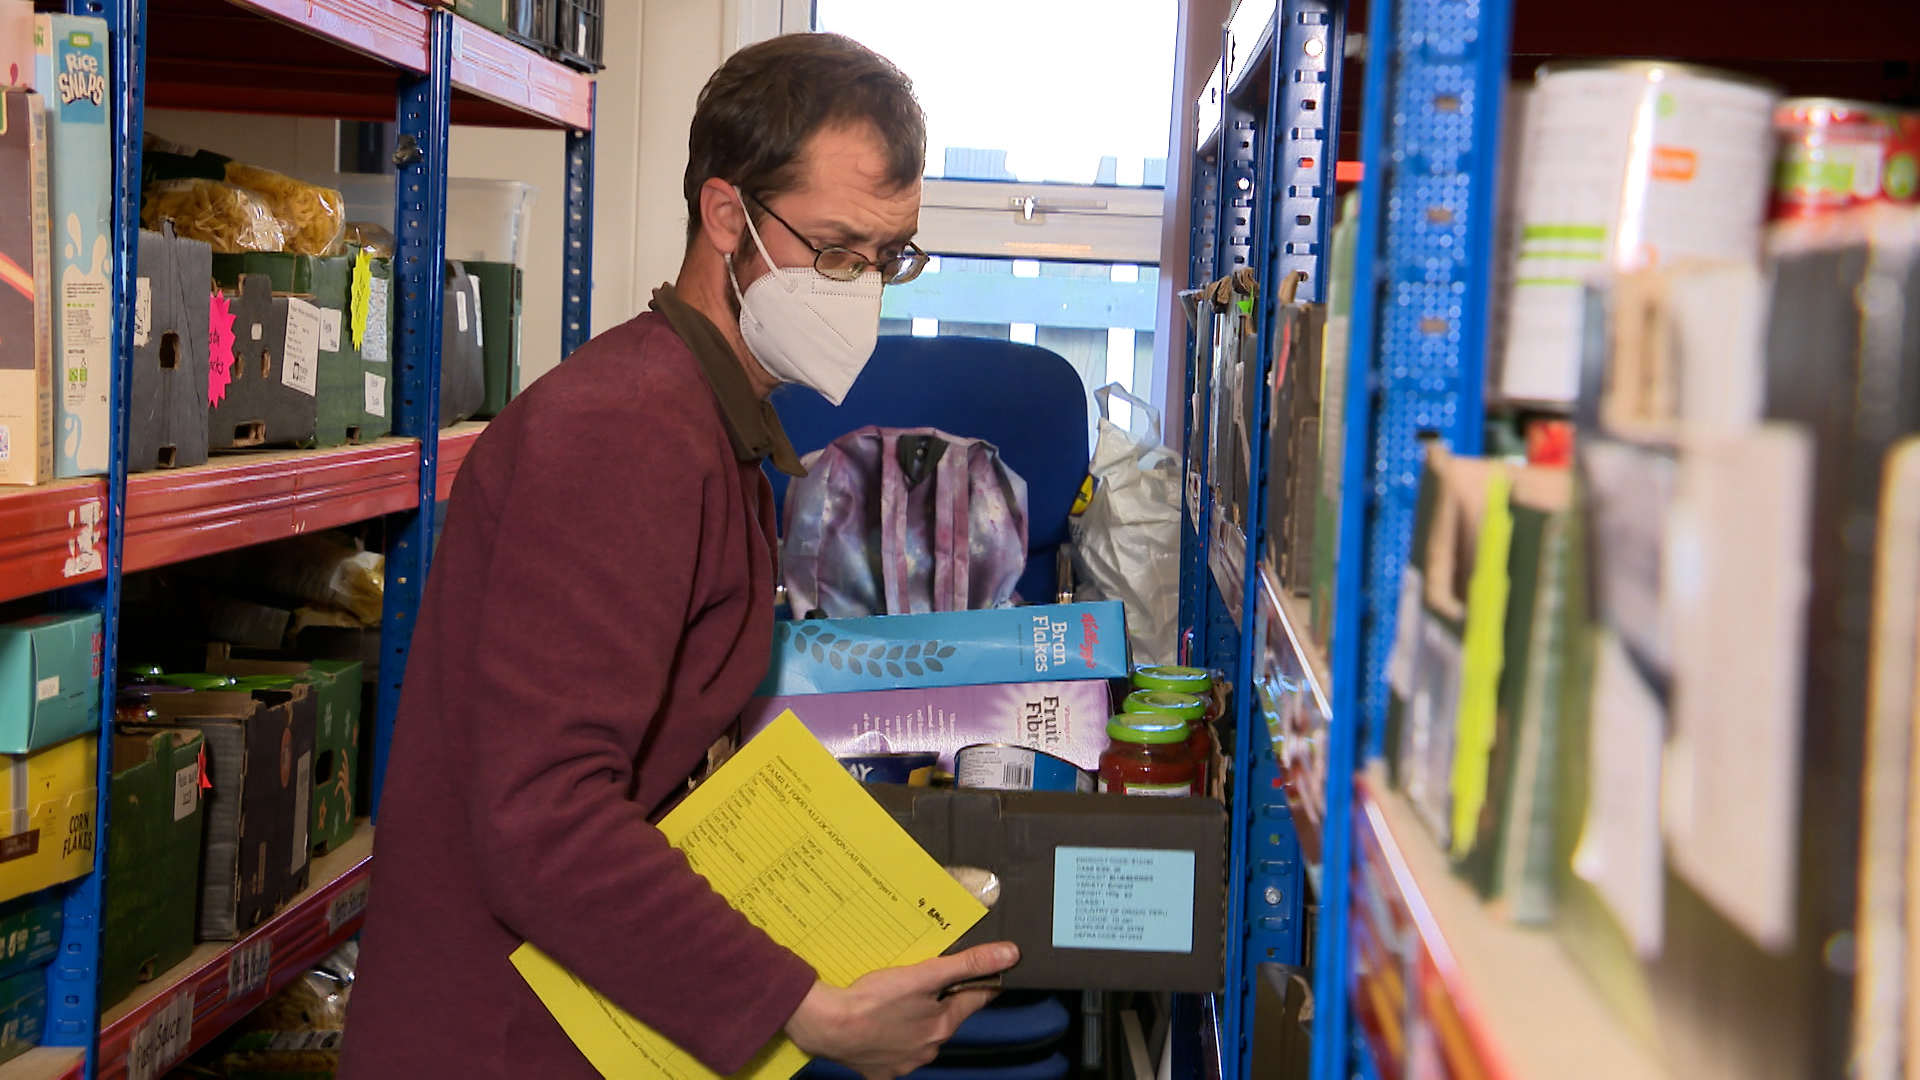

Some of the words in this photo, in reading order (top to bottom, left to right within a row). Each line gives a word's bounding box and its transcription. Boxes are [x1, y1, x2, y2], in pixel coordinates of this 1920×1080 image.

[65, 50, 98, 74] Rice
[58, 71, 105, 107] SNAPS
[1032, 615, 1051, 673] Flakes
[1051, 621, 1067, 666] Bran
[1080, 612, 1099, 669] Kellogg's
[1043, 695, 1062, 743] Fruit
[69, 811, 90, 834] CORN
[763, 762, 791, 790] FAMILY
[786, 787, 810, 810] FOOD
[804, 806, 849, 852] ALLOCATION
[62, 831, 93, 860] FLAKES
